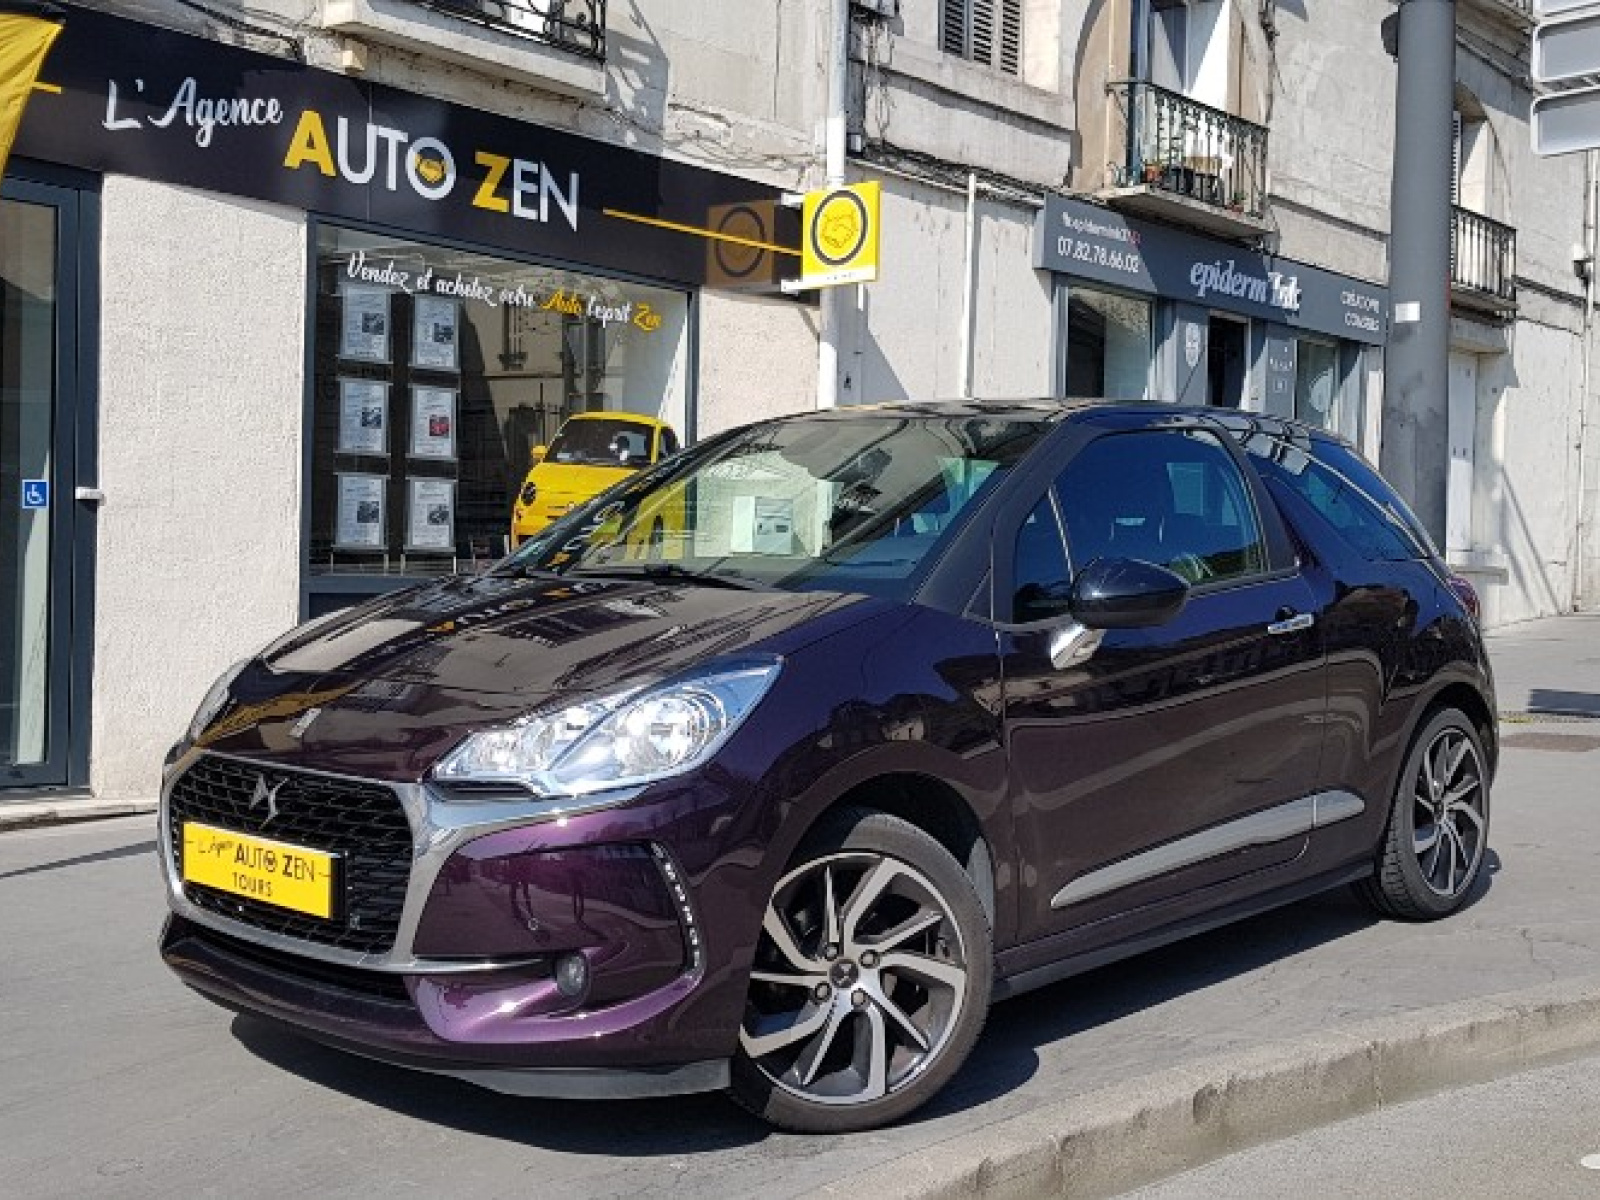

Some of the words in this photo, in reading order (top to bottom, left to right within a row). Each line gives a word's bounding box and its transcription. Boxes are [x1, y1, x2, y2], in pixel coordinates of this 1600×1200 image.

[102, 77, 283, 148] L'Agence
[283, 109, 457, 200] AUTO
[472, 150, 580, 232] ZEN
[347, 250, 413, 295] Vendez
[416, 267, 433, 290] et
[436, 272, 498, 307] achetez
[232, 871, 274, 897] TOURS
[234, 843, 278, 872] AUTO
[282, 854, 315, 882] ZEN
